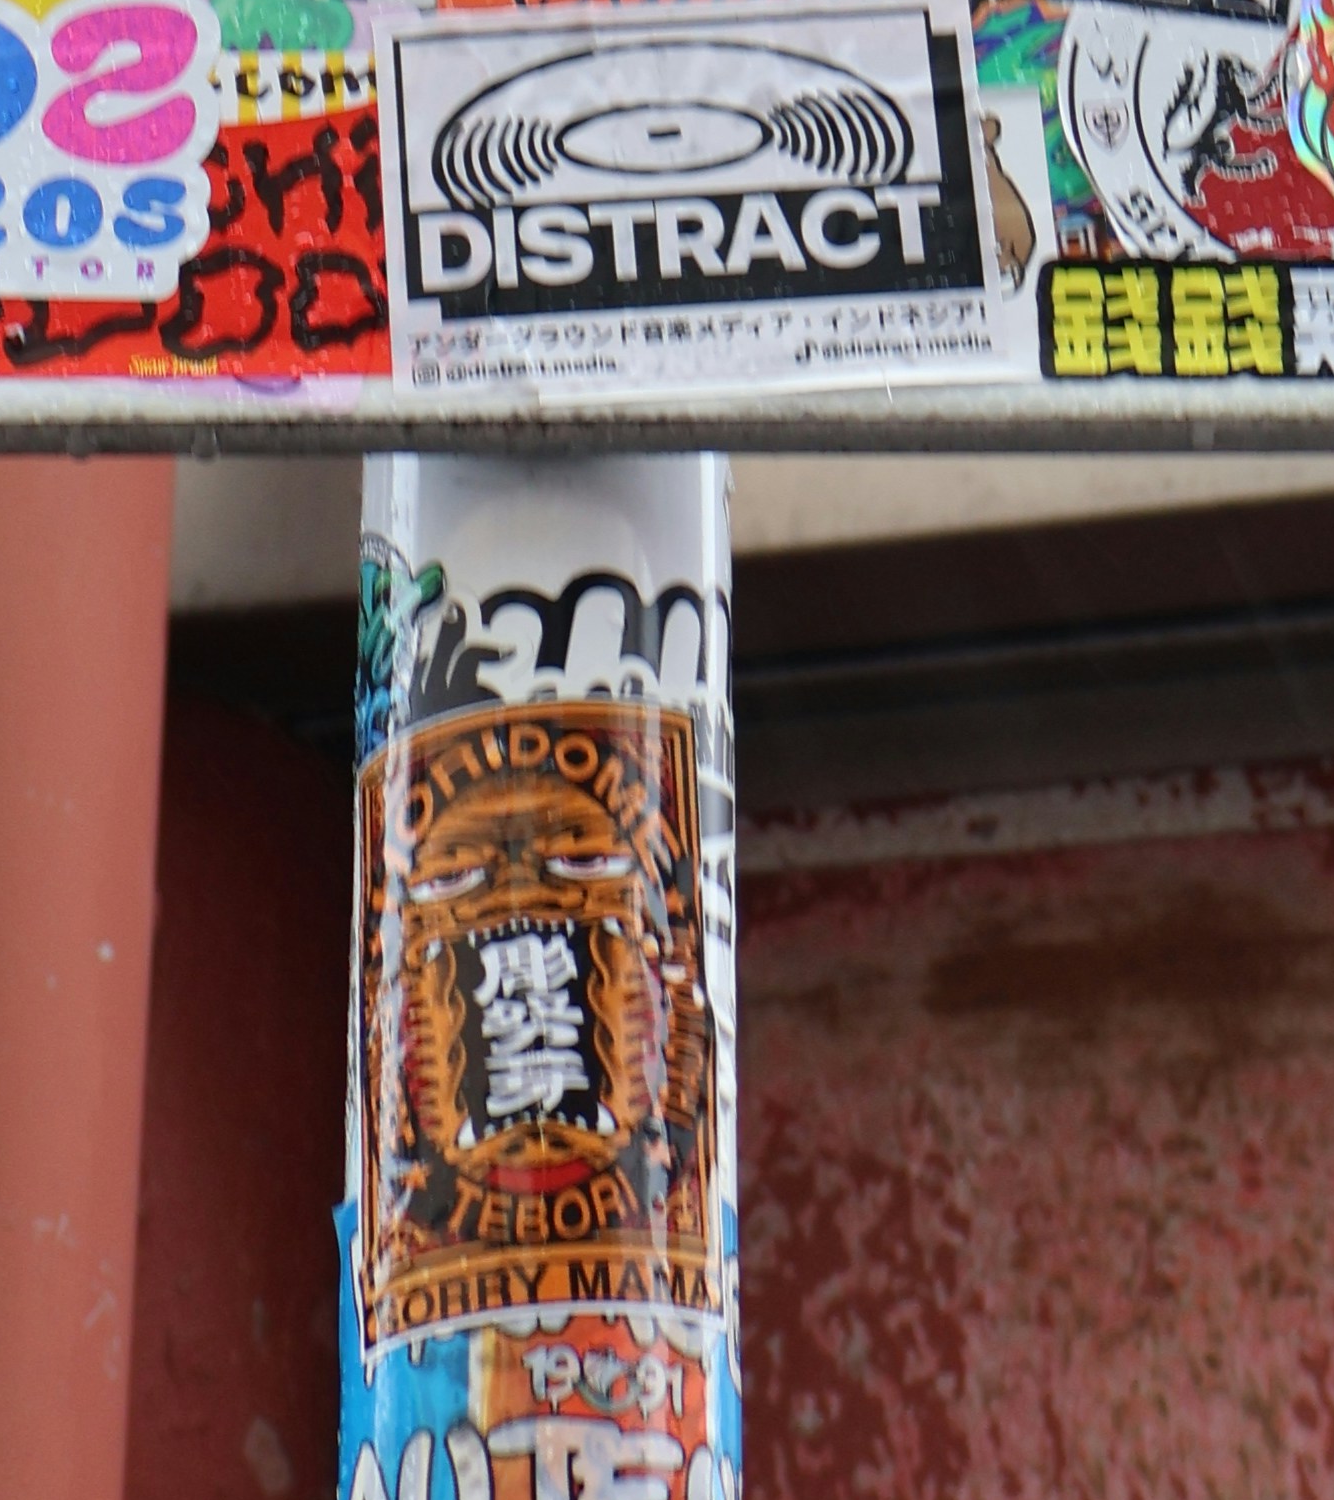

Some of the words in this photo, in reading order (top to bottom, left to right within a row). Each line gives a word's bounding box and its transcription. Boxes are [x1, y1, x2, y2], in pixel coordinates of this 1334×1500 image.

[418, 186, 942, 295] DISTRACT
[370, 1260, 549, 1336] ORRY
[569, 1258, 711, 1320] MAMA
